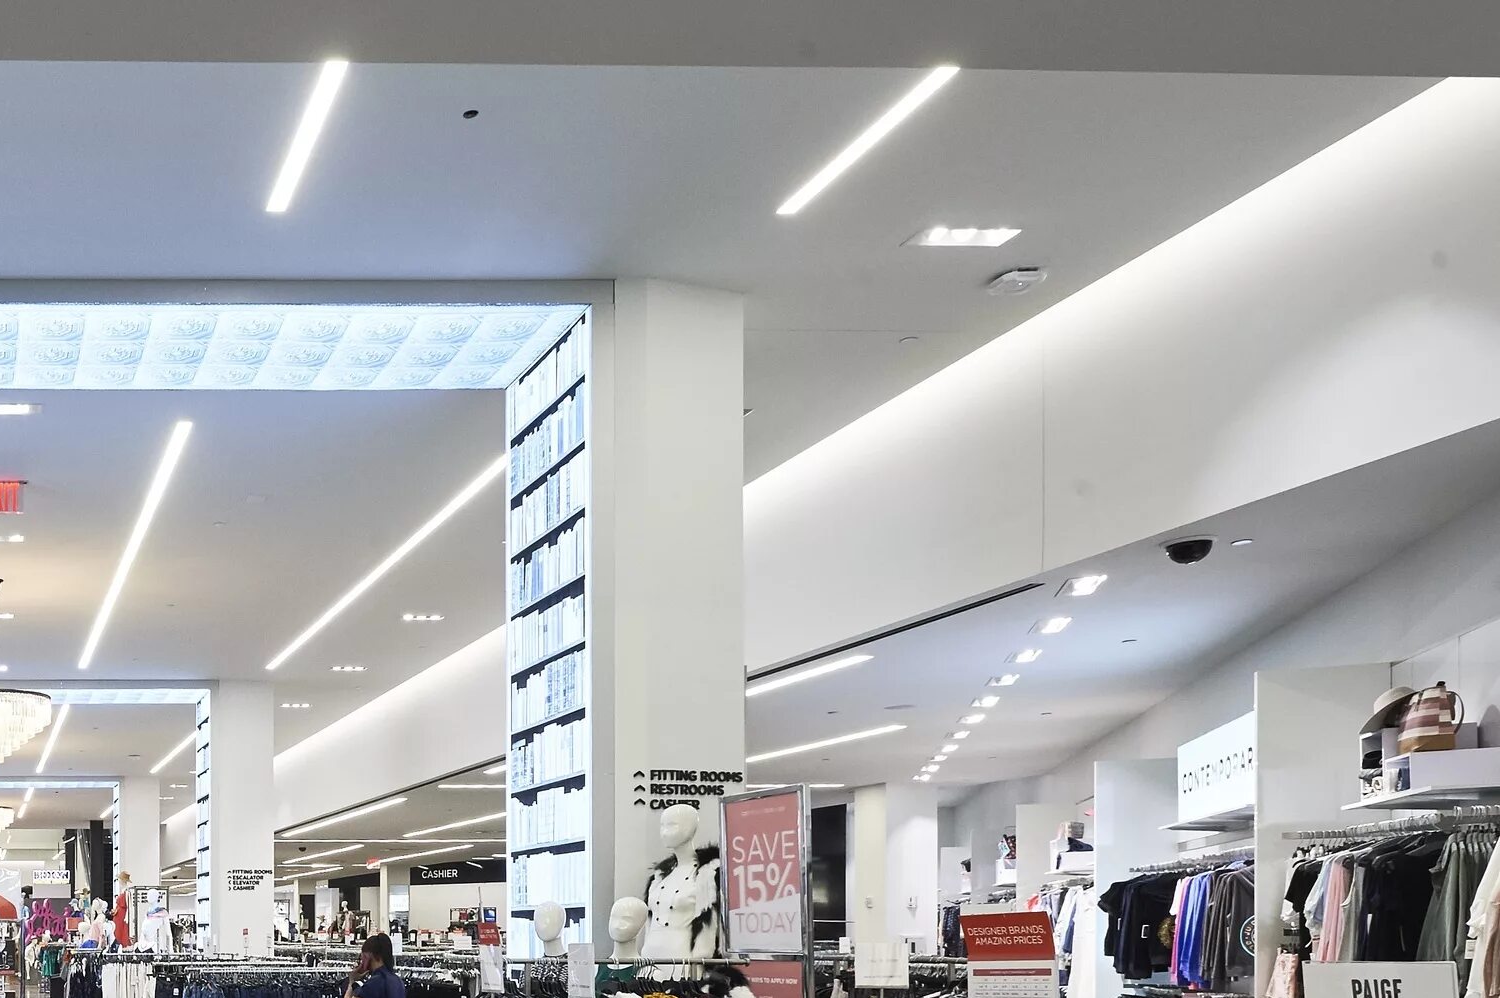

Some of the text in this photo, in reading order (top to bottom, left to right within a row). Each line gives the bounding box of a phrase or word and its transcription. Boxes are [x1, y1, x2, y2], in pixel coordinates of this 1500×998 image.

[650, 769, 743, 783] FITTING ROOMS
[650, 783, 725, 796] RESTROOMS
[732, 830, 796, 864] SAVE
[421, 868, 458, 879] CASHIER
[732, 862, 797, 909] 15%
[734, 911, 797, 934] TODAY
[967, 927, 1008, 937] DESIGNER
[975, 935, 1043, 946] AMAZING PRICES
